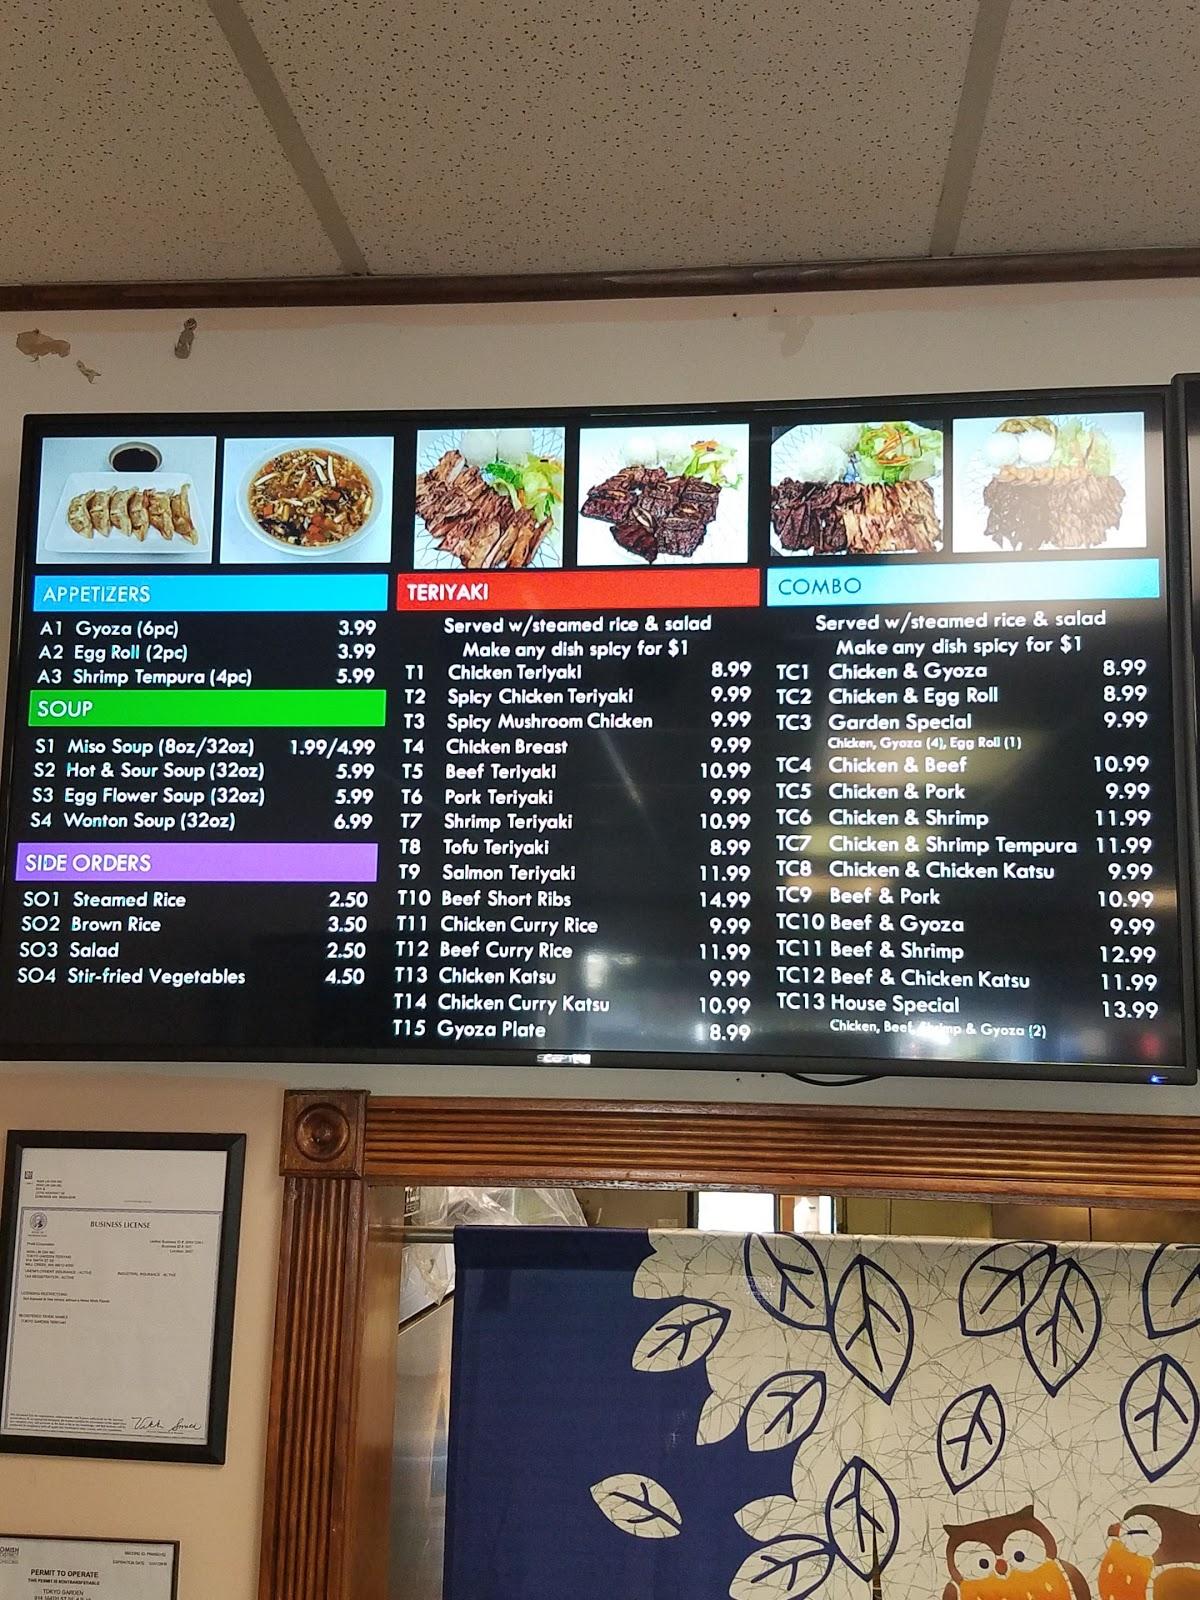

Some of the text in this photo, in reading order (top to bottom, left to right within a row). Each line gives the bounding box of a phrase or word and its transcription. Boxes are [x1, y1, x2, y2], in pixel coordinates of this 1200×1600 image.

[43, 585, 150, 603] APPETIZERS
[406, 583, 488, 601] TERIYAKI
[778, 577, 862, 595] COMBO
[39, 619, 377, 639] A1 Gyoza (6pc) 3.99
[443, 614, 712, 637] Served w/steamed rice & salad
[38, 643, 376, 663] A2 Egg Roll (2pc) 3.99
[462, 638, 688, 661] Make any dish spicy for $1
[36, 667, 375, 688] A3 Shrimp Tempura (4pc) 5.99
[405, 660, 752, 683] T1 Chicken Teriyaki 8.99
[775, 684, 1148, 707] TC2 Chicken & Egg Roll 8.99
[37, 700, 93, 717] SOUP
[403, 710, 752, 733] T3 Spicy Mushroom Chicken 9.99
[35, 736, 376, 759] S1 Miso Soup (8oz/32oz) 1.99/4.99
[827, 736, 1022, 751] Chicken, Gyoza (4), Egg Roll (1)
[33, 761, 375, 781] S2 Hot & Sour Soup (32oz) 5.99
[775, 755, 1150, 773] TC4 Chicken & Beef 10.99
[31, 786, 374, 807] S3 Egg Flower Soup (32oz) 5.99
[30, 811, 373, 832] S4 Wonton Soup (32oz) 6.99
[400, 812, 751, 833] T7 Shrimp Teriyaki 10.99
[775, 808, 1151, 830] TC6 Chicken & Shrimp 11.99
[24, 854, 151, 872] SIDE ORDERS
[398, 863, 751, 884] T9 Salmon Teriyaki 11.99
[23, 891, 368, 908] SO1 Steamed Rice 2.50
[775, 883, 1155, 908] TC9 Beef & Pork 10.99
[21, 915, 367, 933] SO2 Brown Rice 3.50
[396, 915, 751, 936] T11 Chicken Curry Rice 9.99
[19, 941, 366, 959] SO3 Salad 2.50
[17, 967, 365, 988] SO4 Stir-fried Vegetables 4.50
[394, 966, 751, 988] T13 Chicken Katsu 9.99
[776, 991, 1159, 1019] TC13 House Special 13.99
[829, 1018, 881, 1034] Chicken,
[965, 1023, 977, 1035] &
[980, 1023, 1025, 1038] Gyoza
[1028, 1024, 1047, 1039] (2)
[90, 1220, 151, 1229] BUSINESS LICENSE
[30, 1568, 99, 1578] PERMIT TO OPERATE
